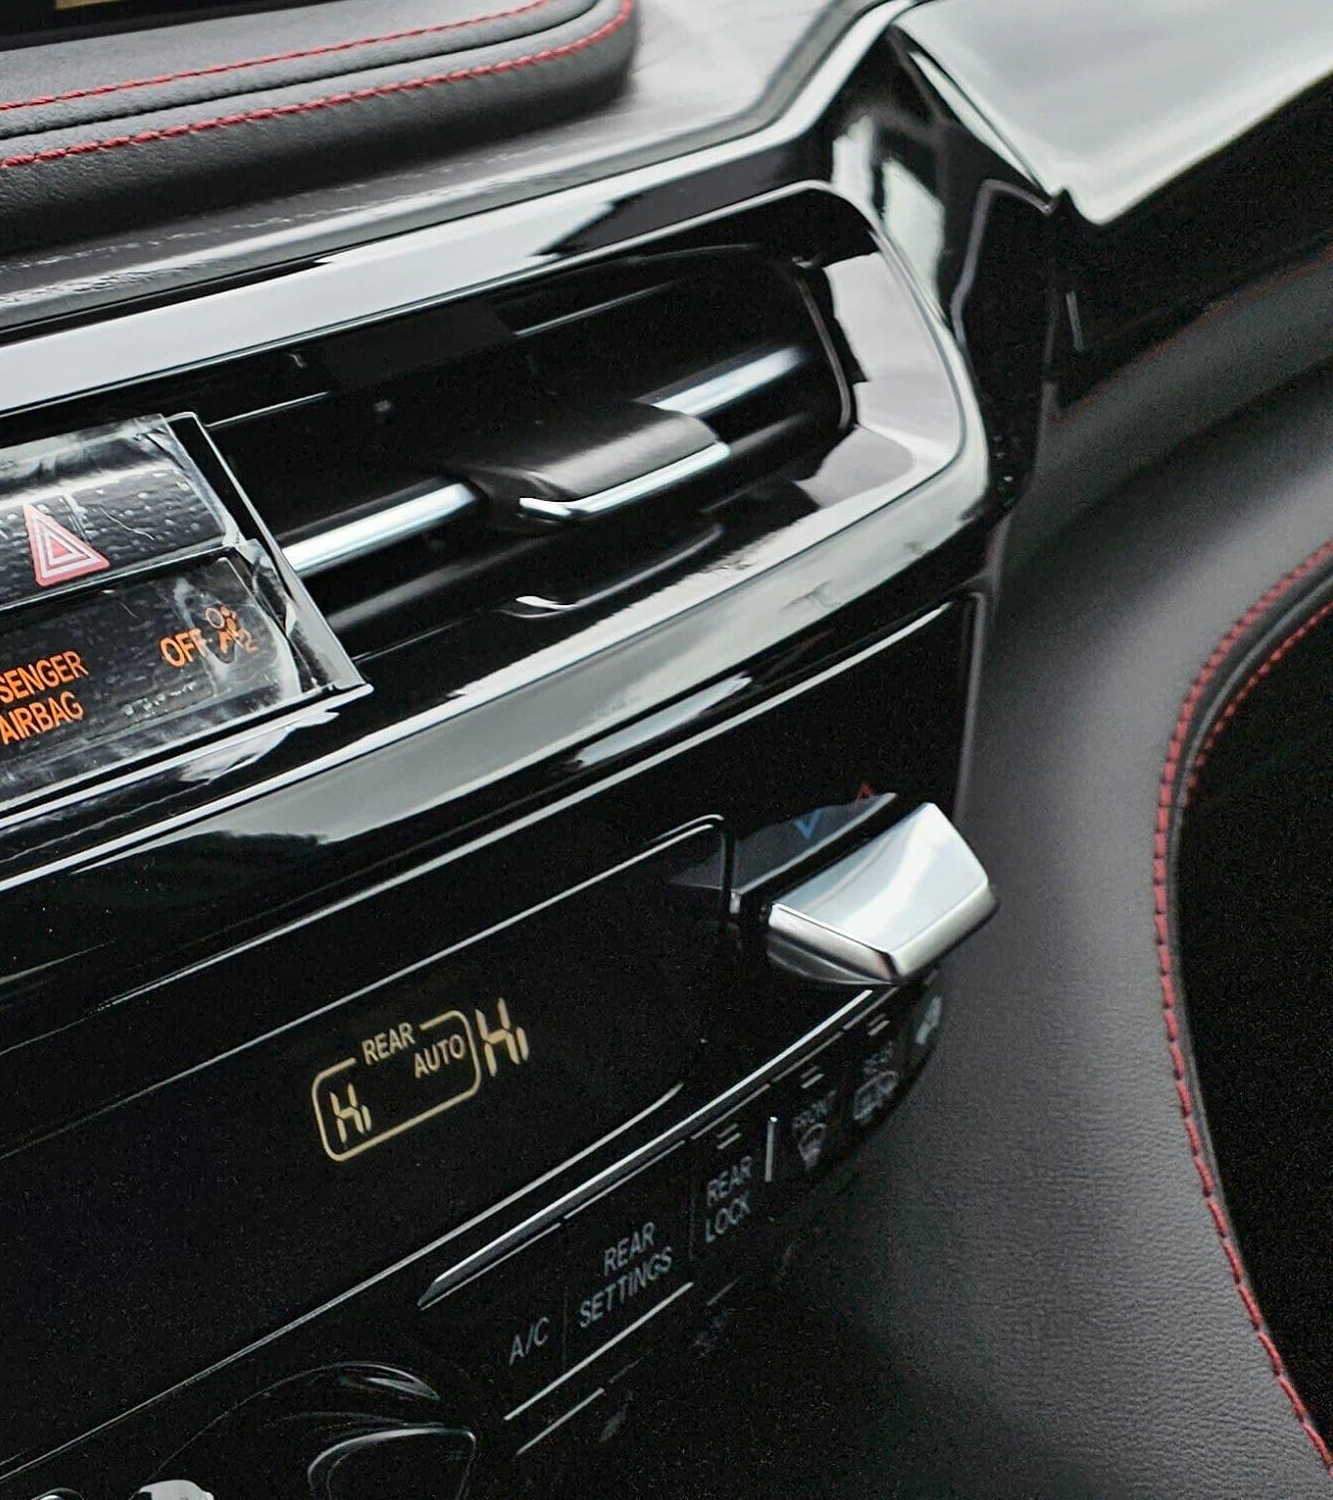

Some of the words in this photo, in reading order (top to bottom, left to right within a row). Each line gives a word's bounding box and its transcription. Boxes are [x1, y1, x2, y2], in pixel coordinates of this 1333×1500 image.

[361, 1022, 416, 1066] REAR
[414, 1033, 465, 1079] AUTO
[705, 1156, 753, 1207] REAR
[705, 1198, 752, 1244] LOCK
[603, 1221, 655, 1277] REAR
[579, 1245, 674, 1329] SETTINGS
[508, 1316, 550, 1366] A/C
